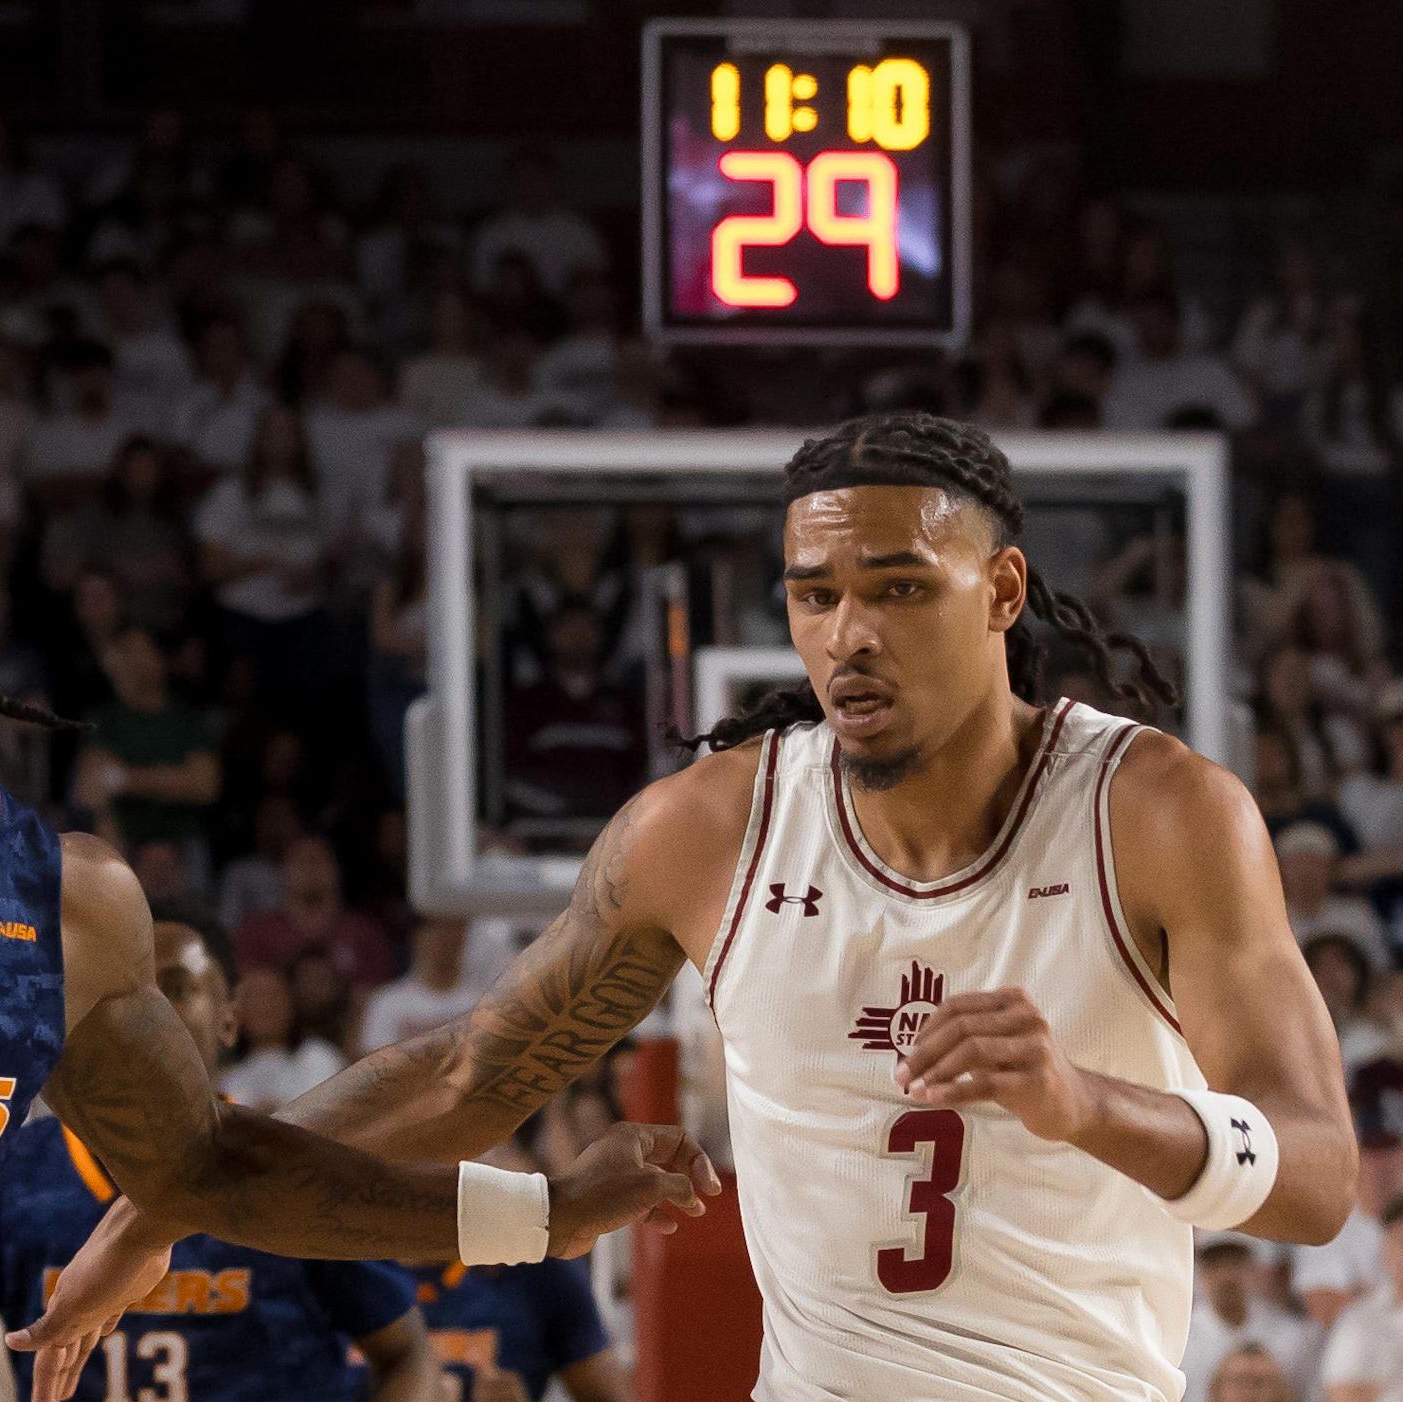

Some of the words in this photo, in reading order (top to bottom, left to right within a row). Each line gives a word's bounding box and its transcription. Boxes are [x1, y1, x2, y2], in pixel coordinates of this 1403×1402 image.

[711, 58, 930, 151] 11:10
[710, 150, 899, 308] 29
[874, 1107, 967, 1296] 3
[42, 1267, 252, 1315] ERS
